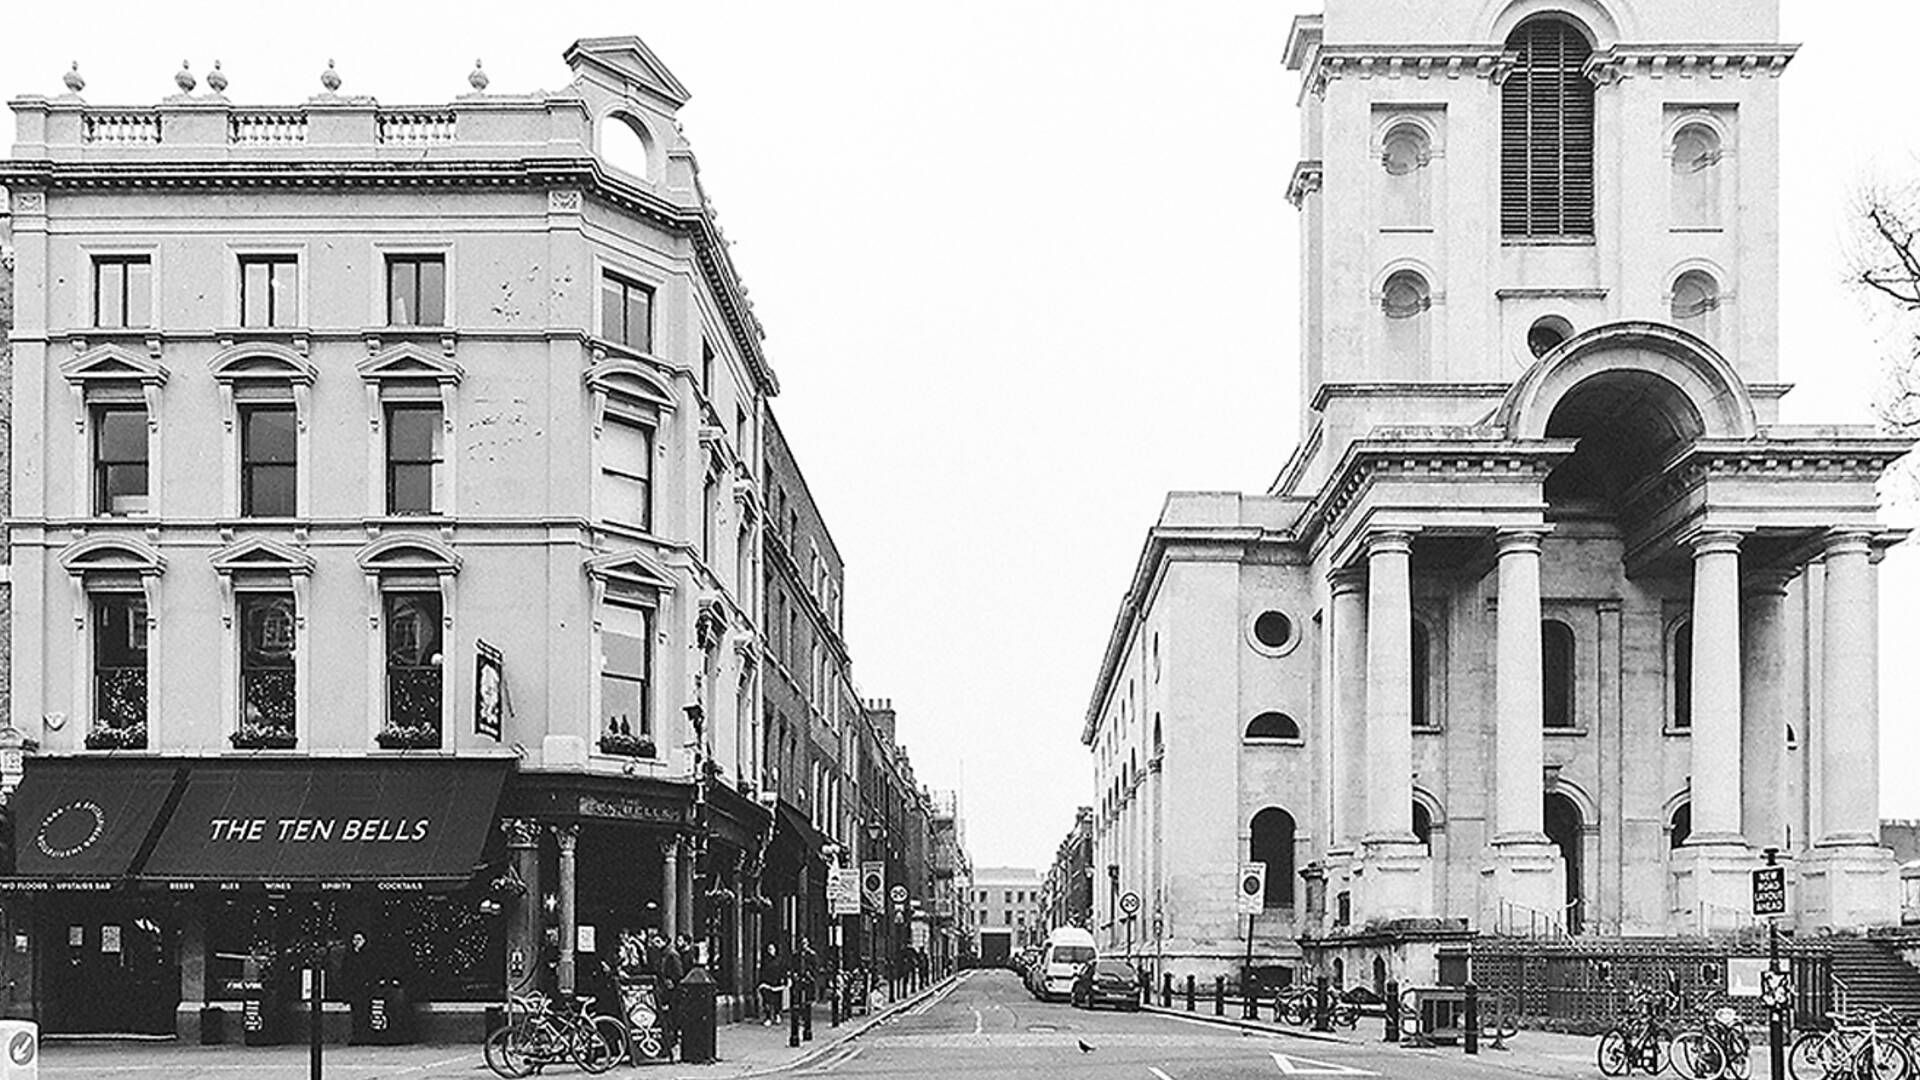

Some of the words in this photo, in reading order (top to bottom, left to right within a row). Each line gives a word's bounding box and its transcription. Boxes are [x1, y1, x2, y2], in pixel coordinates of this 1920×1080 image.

[210, 819, 266, 841] THE
[277, 819, 335, 841] TEN
[340, 819, 429, 841] BELLS
[1758, 871, 1778, 881] NEW
[56, 882, 93, 890] UPSTAIRS
[95, 882, 111, 890] BAR
[169, 882, 195, 890] BEERS
[221, 882, 240, 890] ALES
[264, 882, 292, 890] WINES
[321, 882, 352, 890] SPIRITS
[377, 882, 423, 890] COCKTAILS
[1757, 880, 1780, 891] ROAD
[1754, 890, 1783, 901] LAYOUT
[1123, 898, 1136, 908] 20
[1756, 900, 1783, 911] AHEAD
